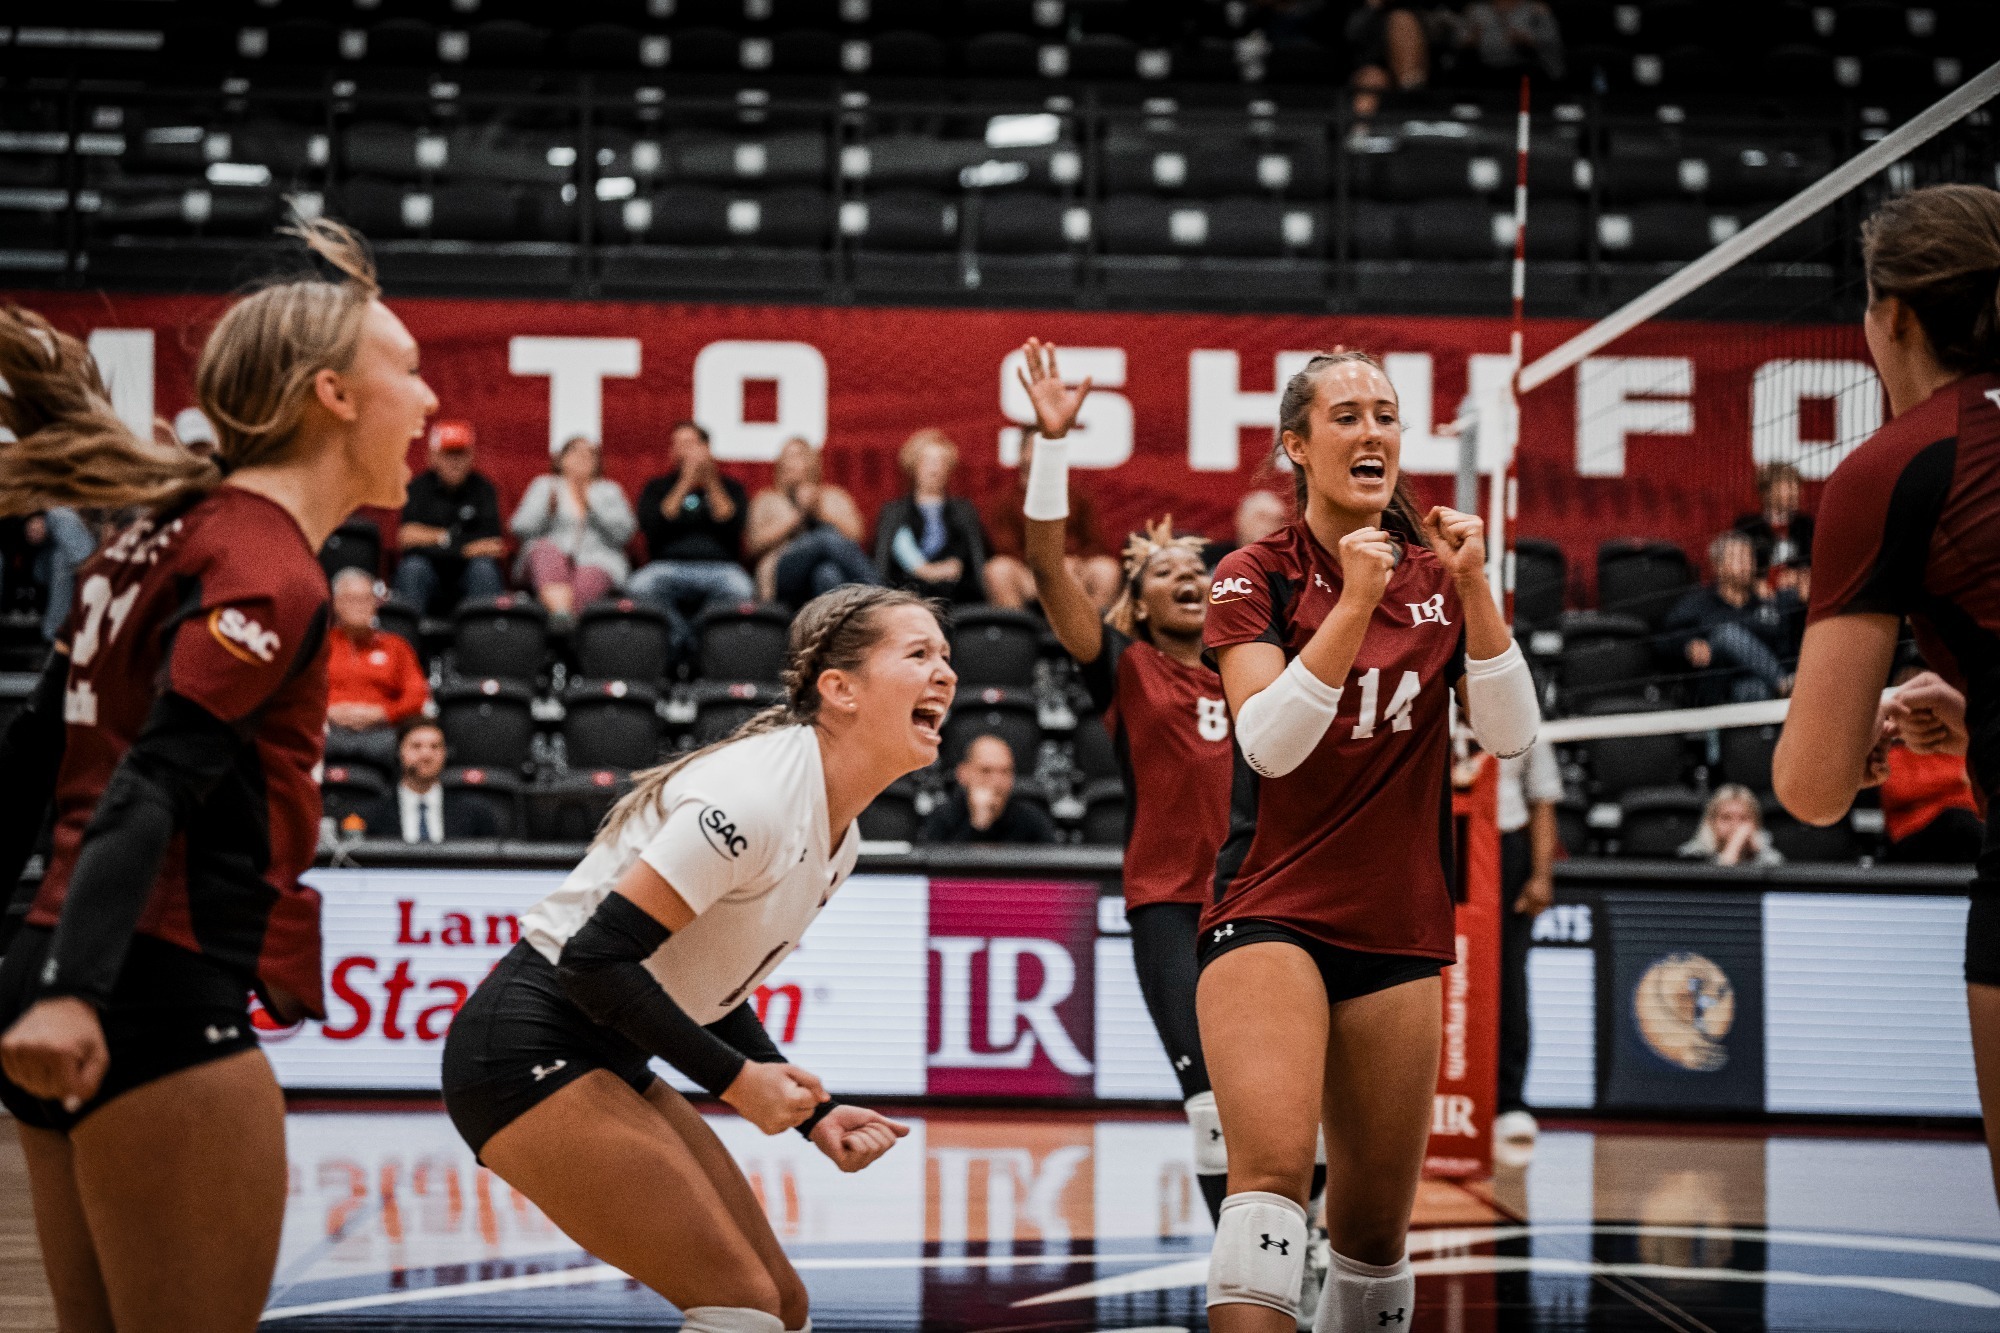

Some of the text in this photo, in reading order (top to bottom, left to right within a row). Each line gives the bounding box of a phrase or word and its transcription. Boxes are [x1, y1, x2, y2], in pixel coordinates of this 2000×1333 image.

[508, 336, 1884, 481] TO SHUFO
[1211, 577, 1252, 599] SAC
[1404, 593, 1452, 629] LR
[218, 608, 281, 663] SAC
[1197, 696, 1228, 741] 8
[1351, 667, 1421, 740] 14
[705, 809, 748, 858] SAC
[397, 900, 522, 945] Lan
[1531, 903, 1593, 942] ATS
[322, 955, 482, 1041] Sta
[928, 936, 1096, 1076] LR
